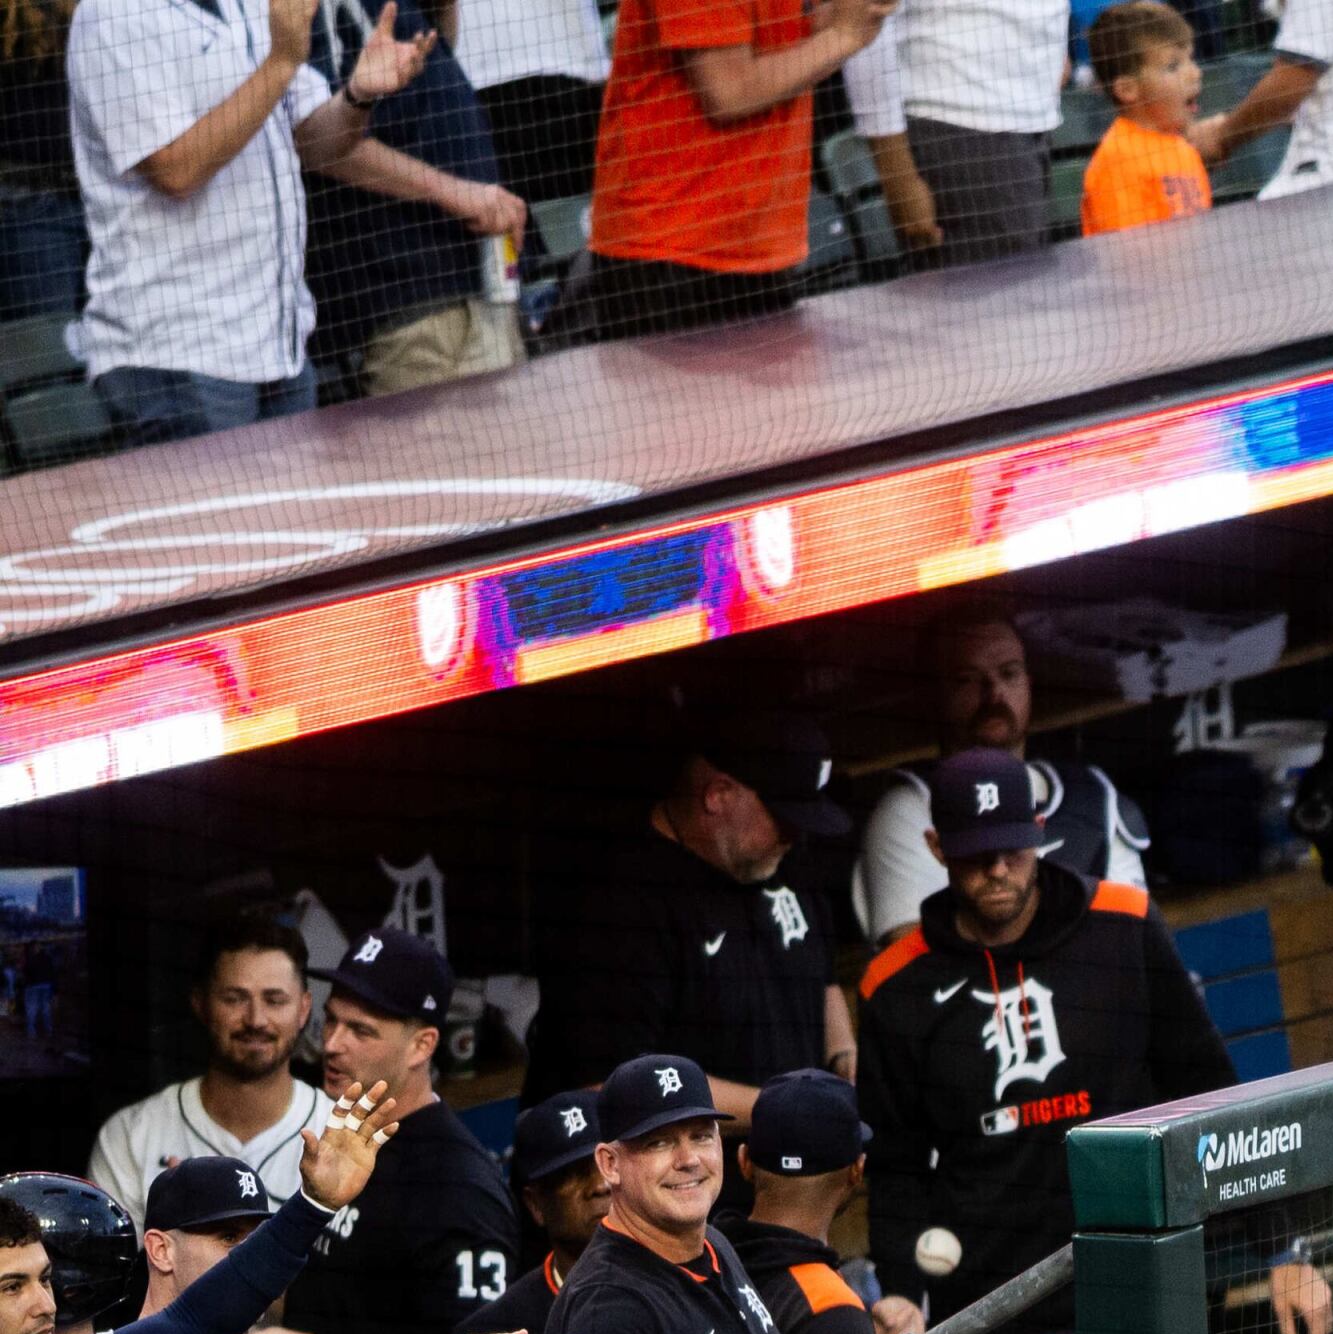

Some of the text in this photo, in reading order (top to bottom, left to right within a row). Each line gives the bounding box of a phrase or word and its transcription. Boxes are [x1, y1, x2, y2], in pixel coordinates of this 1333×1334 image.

[976, 782, 1000, 816] D
[762, 886, 809, 949] D
[353, 935, 384, 963] D
[971, 976, 1067, 1102] D
[654, 1067, 683, 1098] D
[560, 1106, 588, 1138] D
[1021, 1089, 1092, 1126] TIGERS
[1227, 1122, 1302, 1168] McLaren
[235, 1168, 259, 1199] D
[1219, 1168, 1287, 1200] HEALTH CARE
[456, 1250, 507, 1302] 13
[738, 1284, 774, 1333] D
